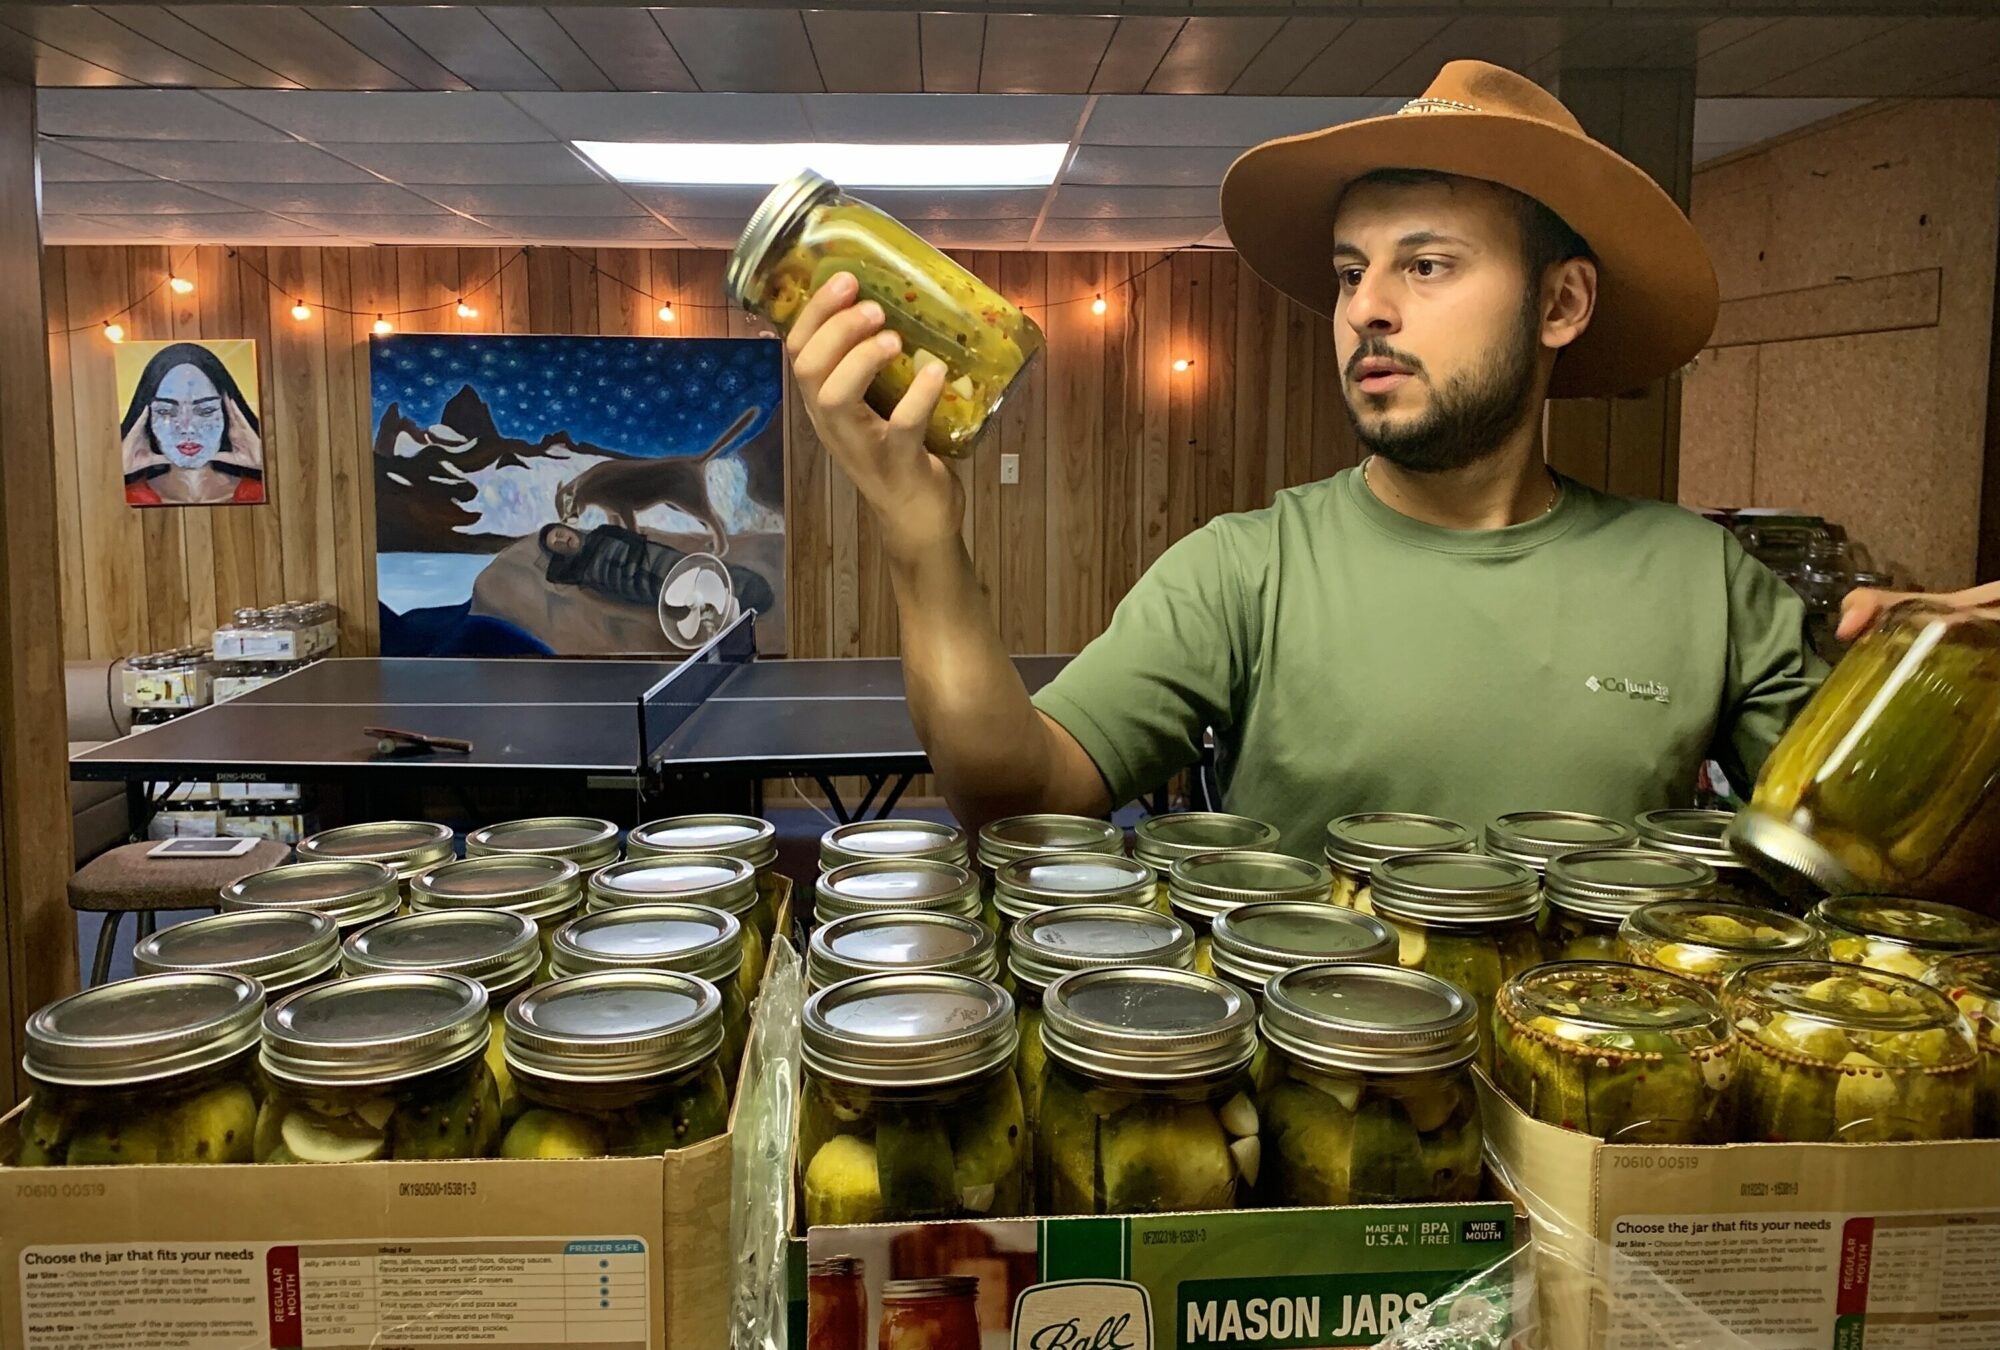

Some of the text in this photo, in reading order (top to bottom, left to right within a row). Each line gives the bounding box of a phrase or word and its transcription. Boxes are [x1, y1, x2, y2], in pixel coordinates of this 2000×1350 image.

[1613, 1155, 1699, 1169] 70610 00519
[16, 1184, 57, 1198] 70610
[1365, 1223, 1408, 1233] MADE IN
[1421, 1222, 1450, 1234] BPA
[1471, 1222, 1497, 1231] WIDE
[1616, 1219, 1831, 1235] Choose the jar that fits your needs
[1365, 1234, 1408, 1246] U.S.A.
[1421, 1234, 1450, 1244] FREE
[1466, 1231, 1502, 1241] MOUTH
[569, 1243, 639, 1252] FREEZER SAFE
[24, 1248, 254, 1265] Choose the jar that fits your needs
[1843, 1238, 1857, 1290] REGULAR
[1857, 1244, 1869, 1284] MOUTH
[273, 1268, 285, 1322] REGULAR
[286, 1273, 296, 1316] MOUTH
[1187, 1296, 1320, 1344] MASON
[1030, 1312, 1135, 1350] Ball
